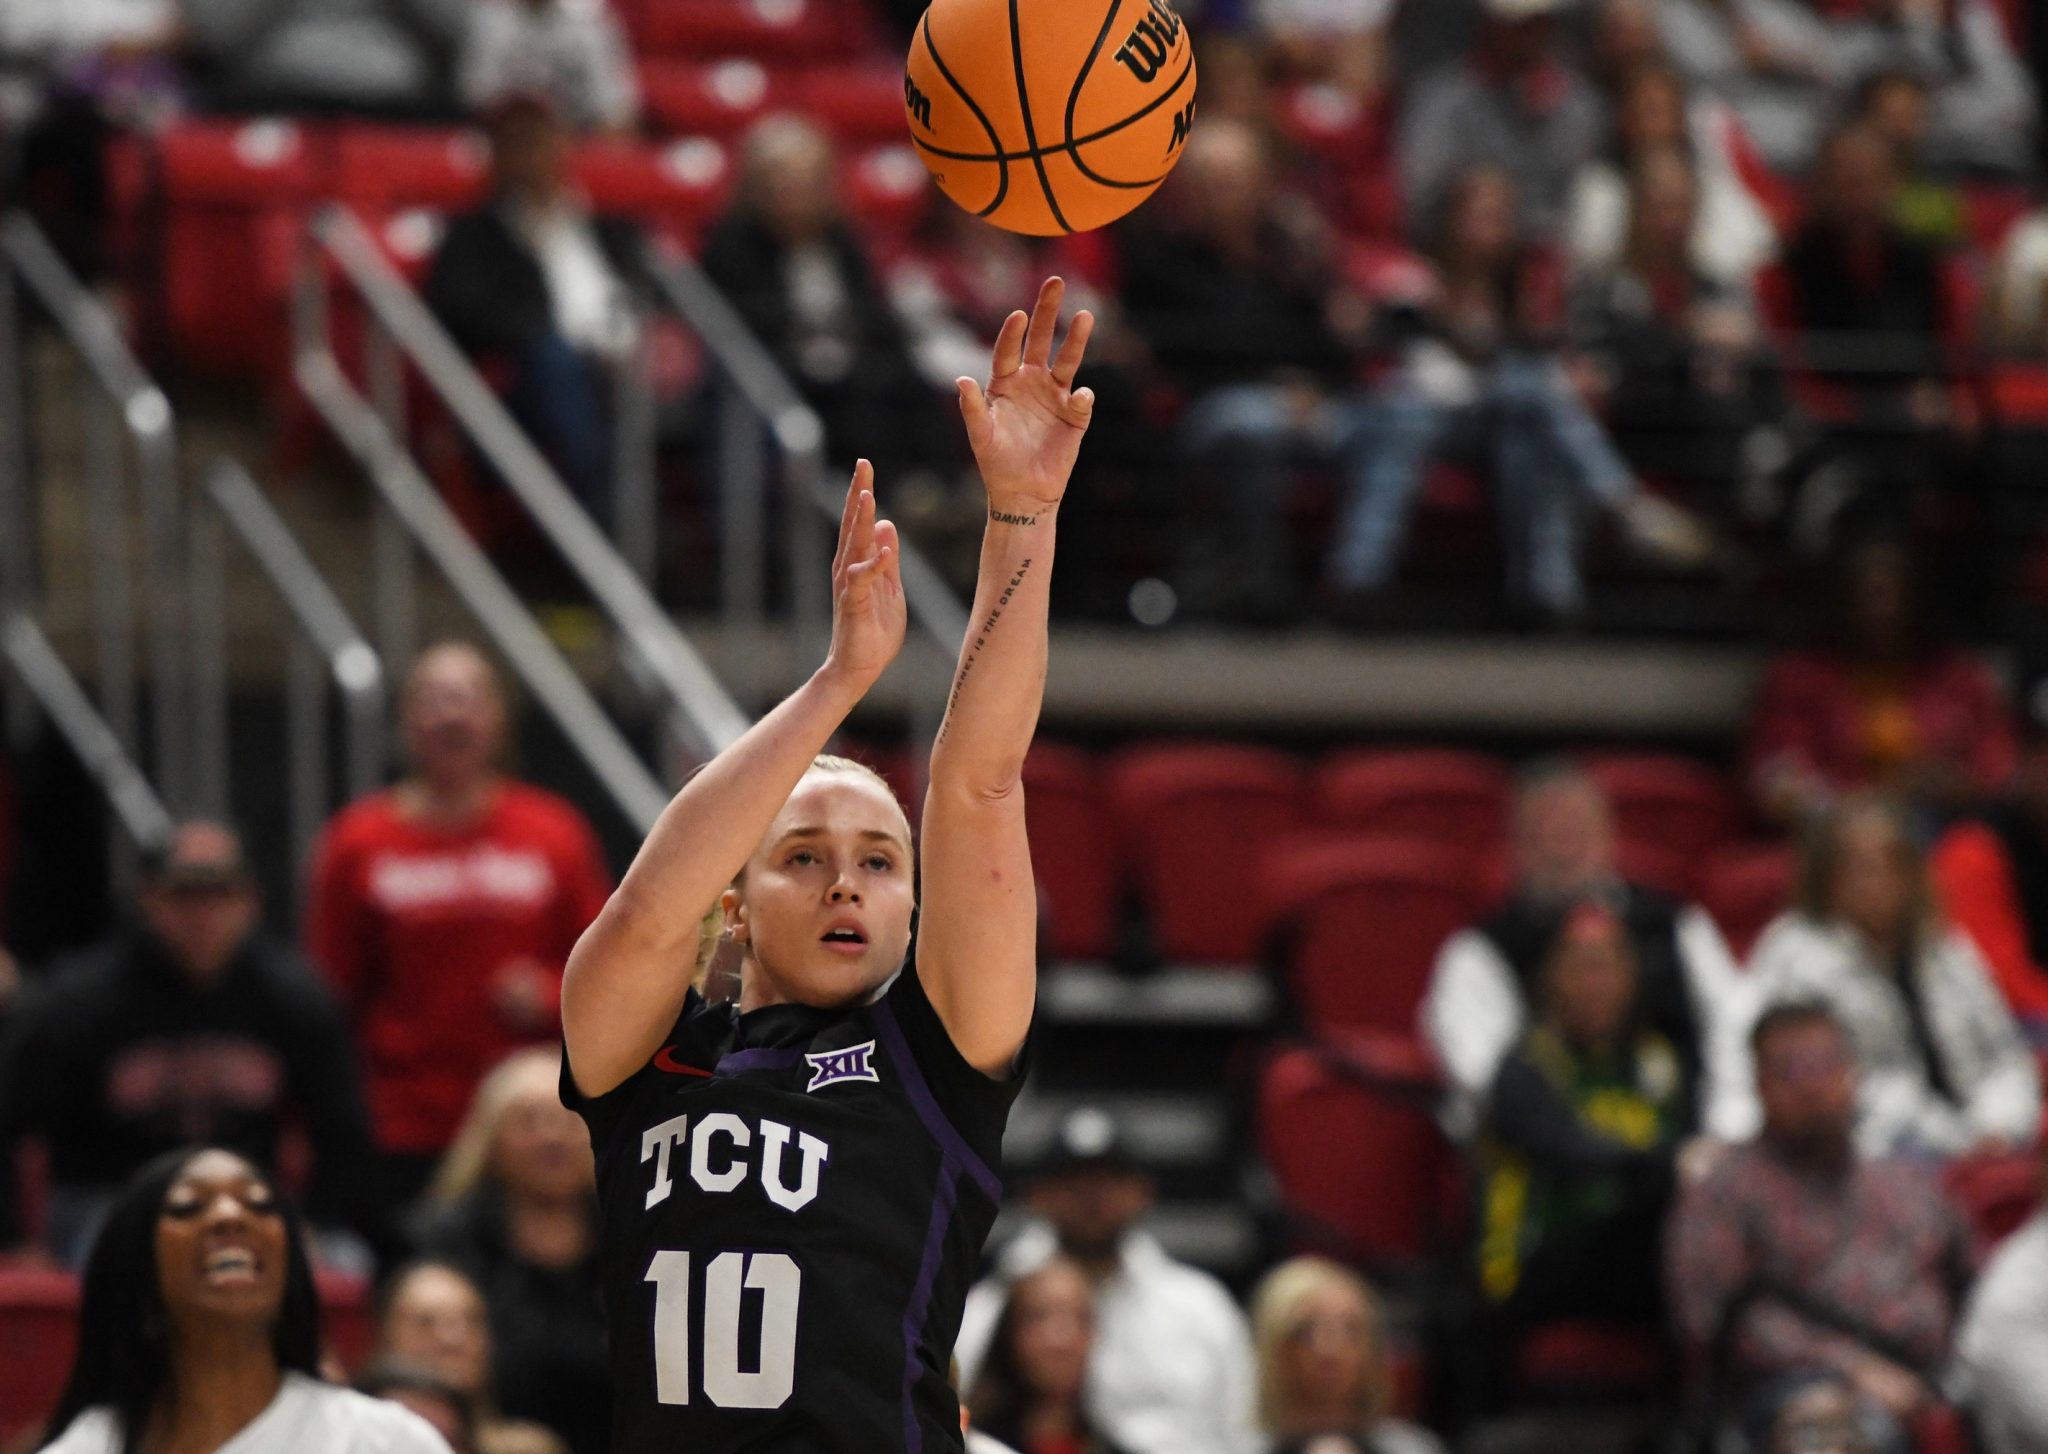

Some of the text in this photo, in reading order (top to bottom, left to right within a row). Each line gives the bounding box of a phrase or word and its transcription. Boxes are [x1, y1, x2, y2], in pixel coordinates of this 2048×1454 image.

[1113, 0, 1179, 83] Wil
[983, 609, 1001, 633] THE
[999, 558, 1032, 605] DREAM
[809, 1044, 875, 1087] XII
[640, 1112, 829, 1213] TCU
[643, 1250, 801, 1409] 10
